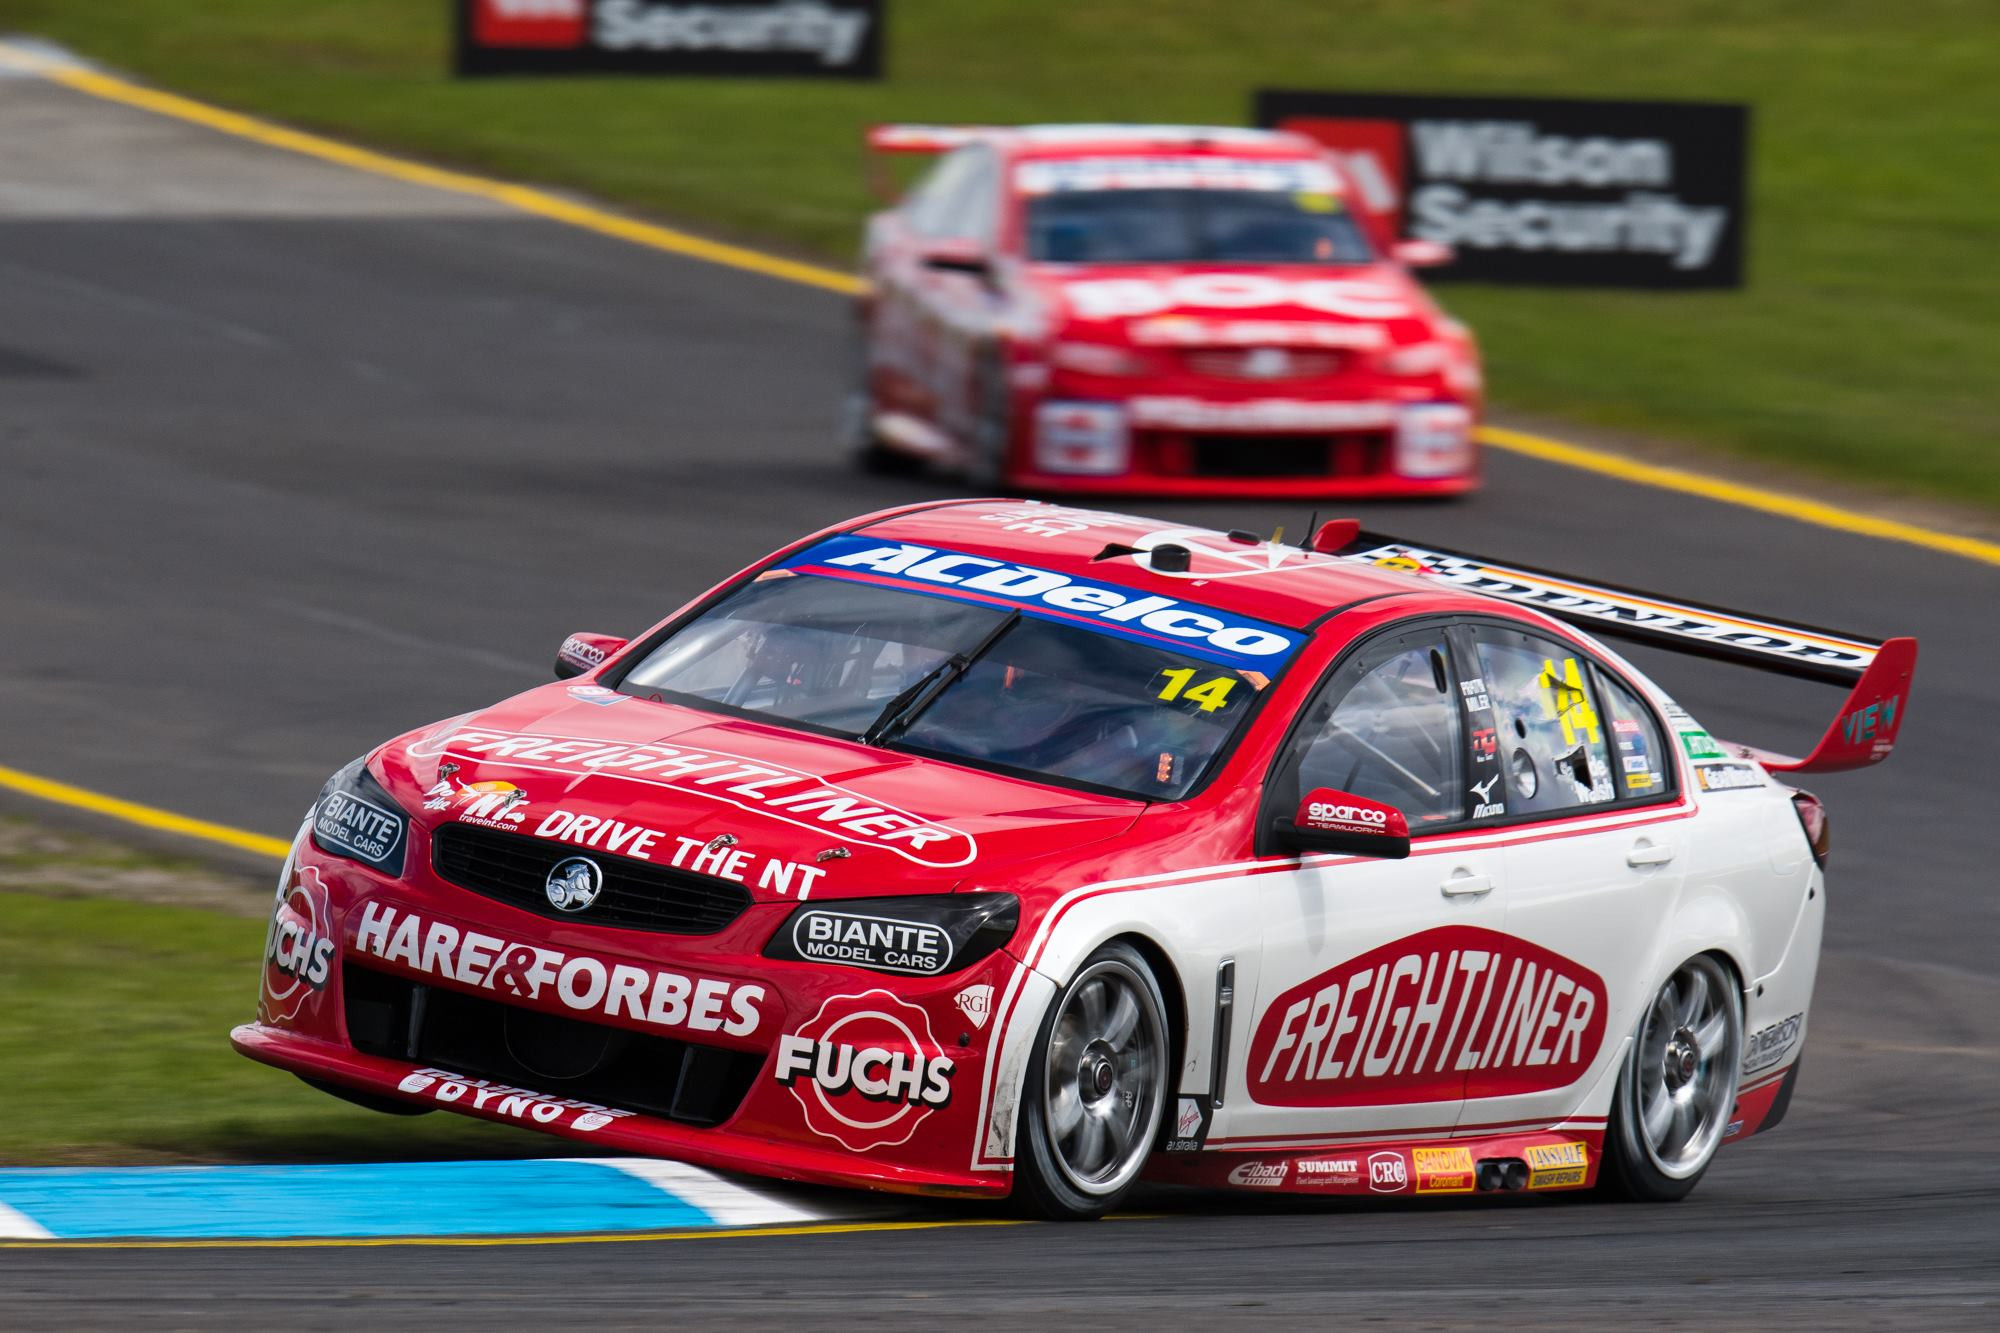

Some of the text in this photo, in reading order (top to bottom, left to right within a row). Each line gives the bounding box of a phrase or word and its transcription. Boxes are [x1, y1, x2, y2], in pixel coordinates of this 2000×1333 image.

[1409, 119, 1671, 187] Wilson
[1409, 186, 1727, 269] Security
[824, 544, 1291, 656] ACDelco
[1461, 577, 1865, 664] DUNLOP
[1157, 667, 1238, 713] 14
[1842, 695, 1899, 744] VIEW
[433, 732, 951, 850] FREIGHTLINER
[1308, 802, 1387, 823] sparco
[318, 819, 385, 858] MODEL CARS
[324, 795, 397, 843] BIANTE
[534, 810, 667, 860] DRIVE
[674, 836, 756, 882] THE
[758, 858, 827, 901] NT
[807, 942, 937, 969] MODEL CARS
[808, 916, 940, 954] BIANTE
[957, 993, 989, 1013] RGI
[1259, 950, 1596, 1083] FREIGHTLINER
[775, 1034, 956, 1107] FUCHS
[435, 1081, 565, 1123] DYNO
[1298, 1160, 1357, 1173] SUMMIT
[1372, 1161, 1406, 1184] CRC
[1416, 1151, 1468, 1171] SANDVIK
